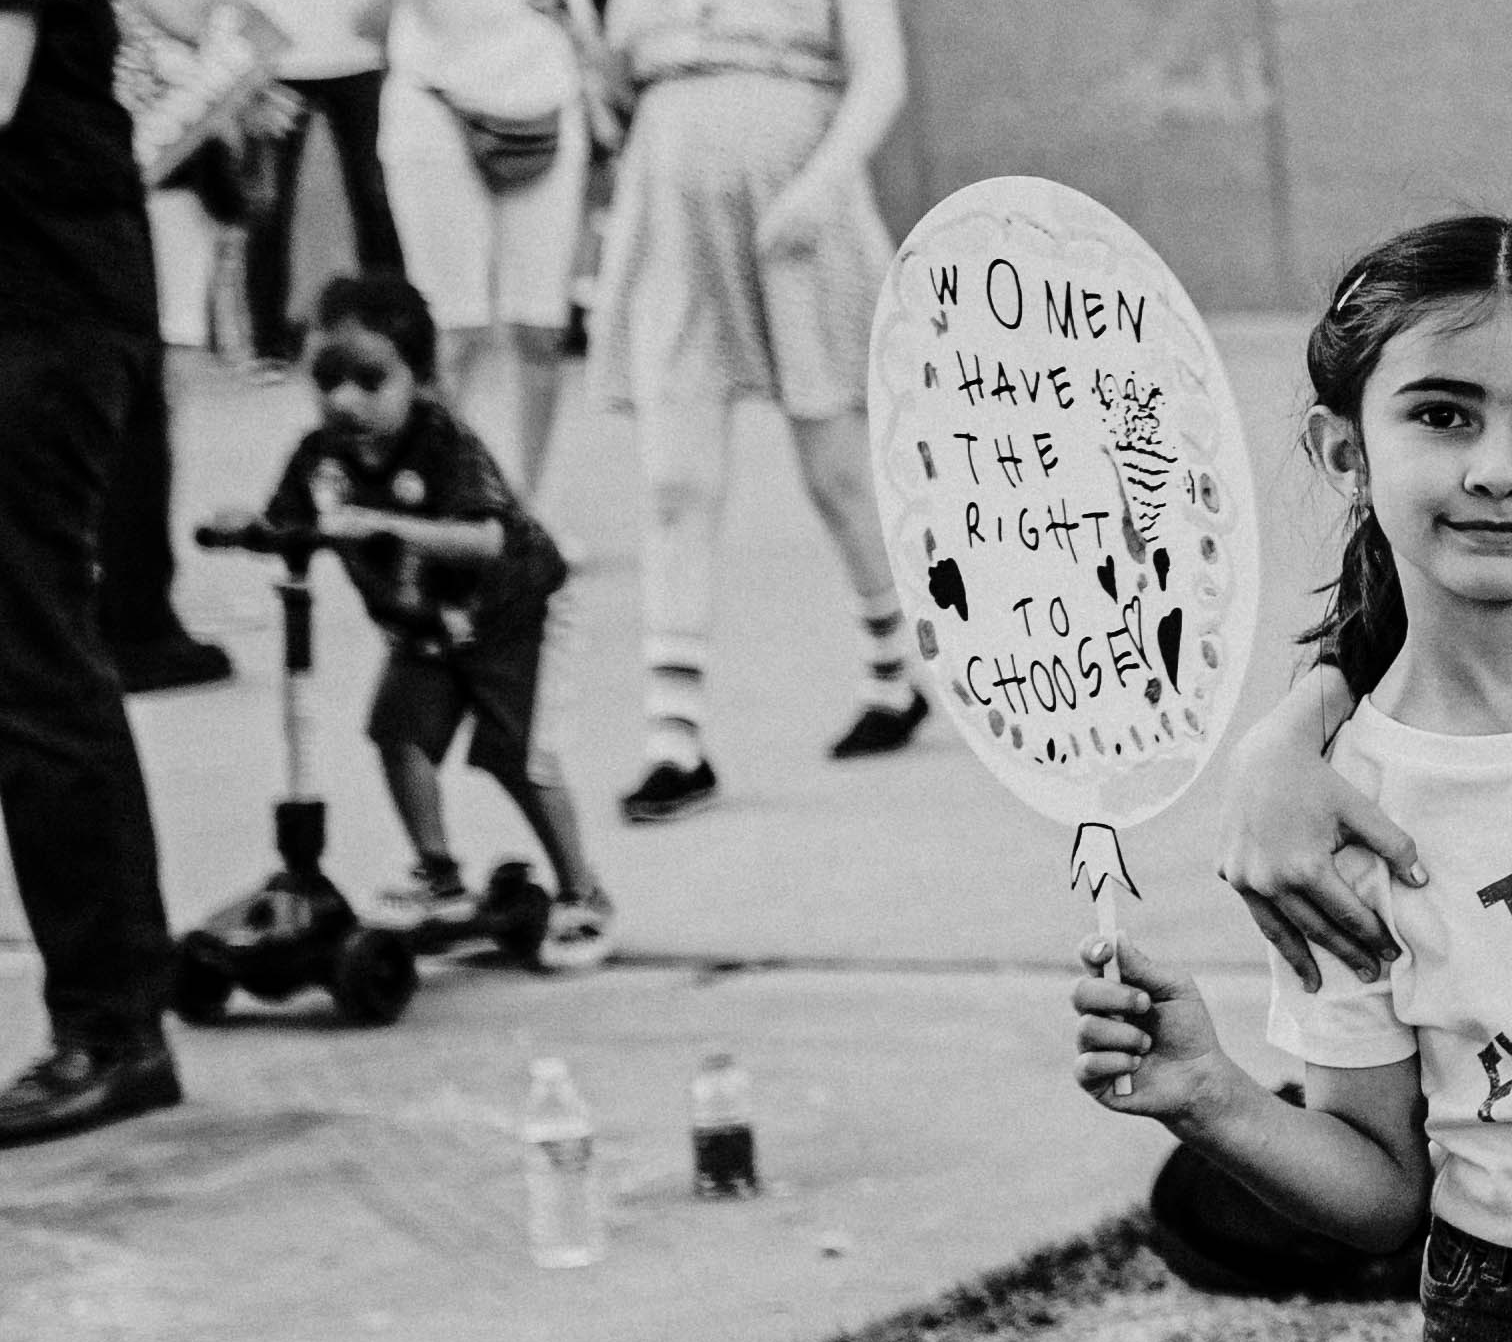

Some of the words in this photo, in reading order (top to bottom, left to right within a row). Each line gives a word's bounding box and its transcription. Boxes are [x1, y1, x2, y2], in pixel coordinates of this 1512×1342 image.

[930, 259, 1144, 342] WOMEN
[957, 350, 1074, 409] HAVE
[954, 433, 1058, 489] THE
[966, 498, 1109, 564] RIGHT
[1013, 596, 1069, 637] TO
